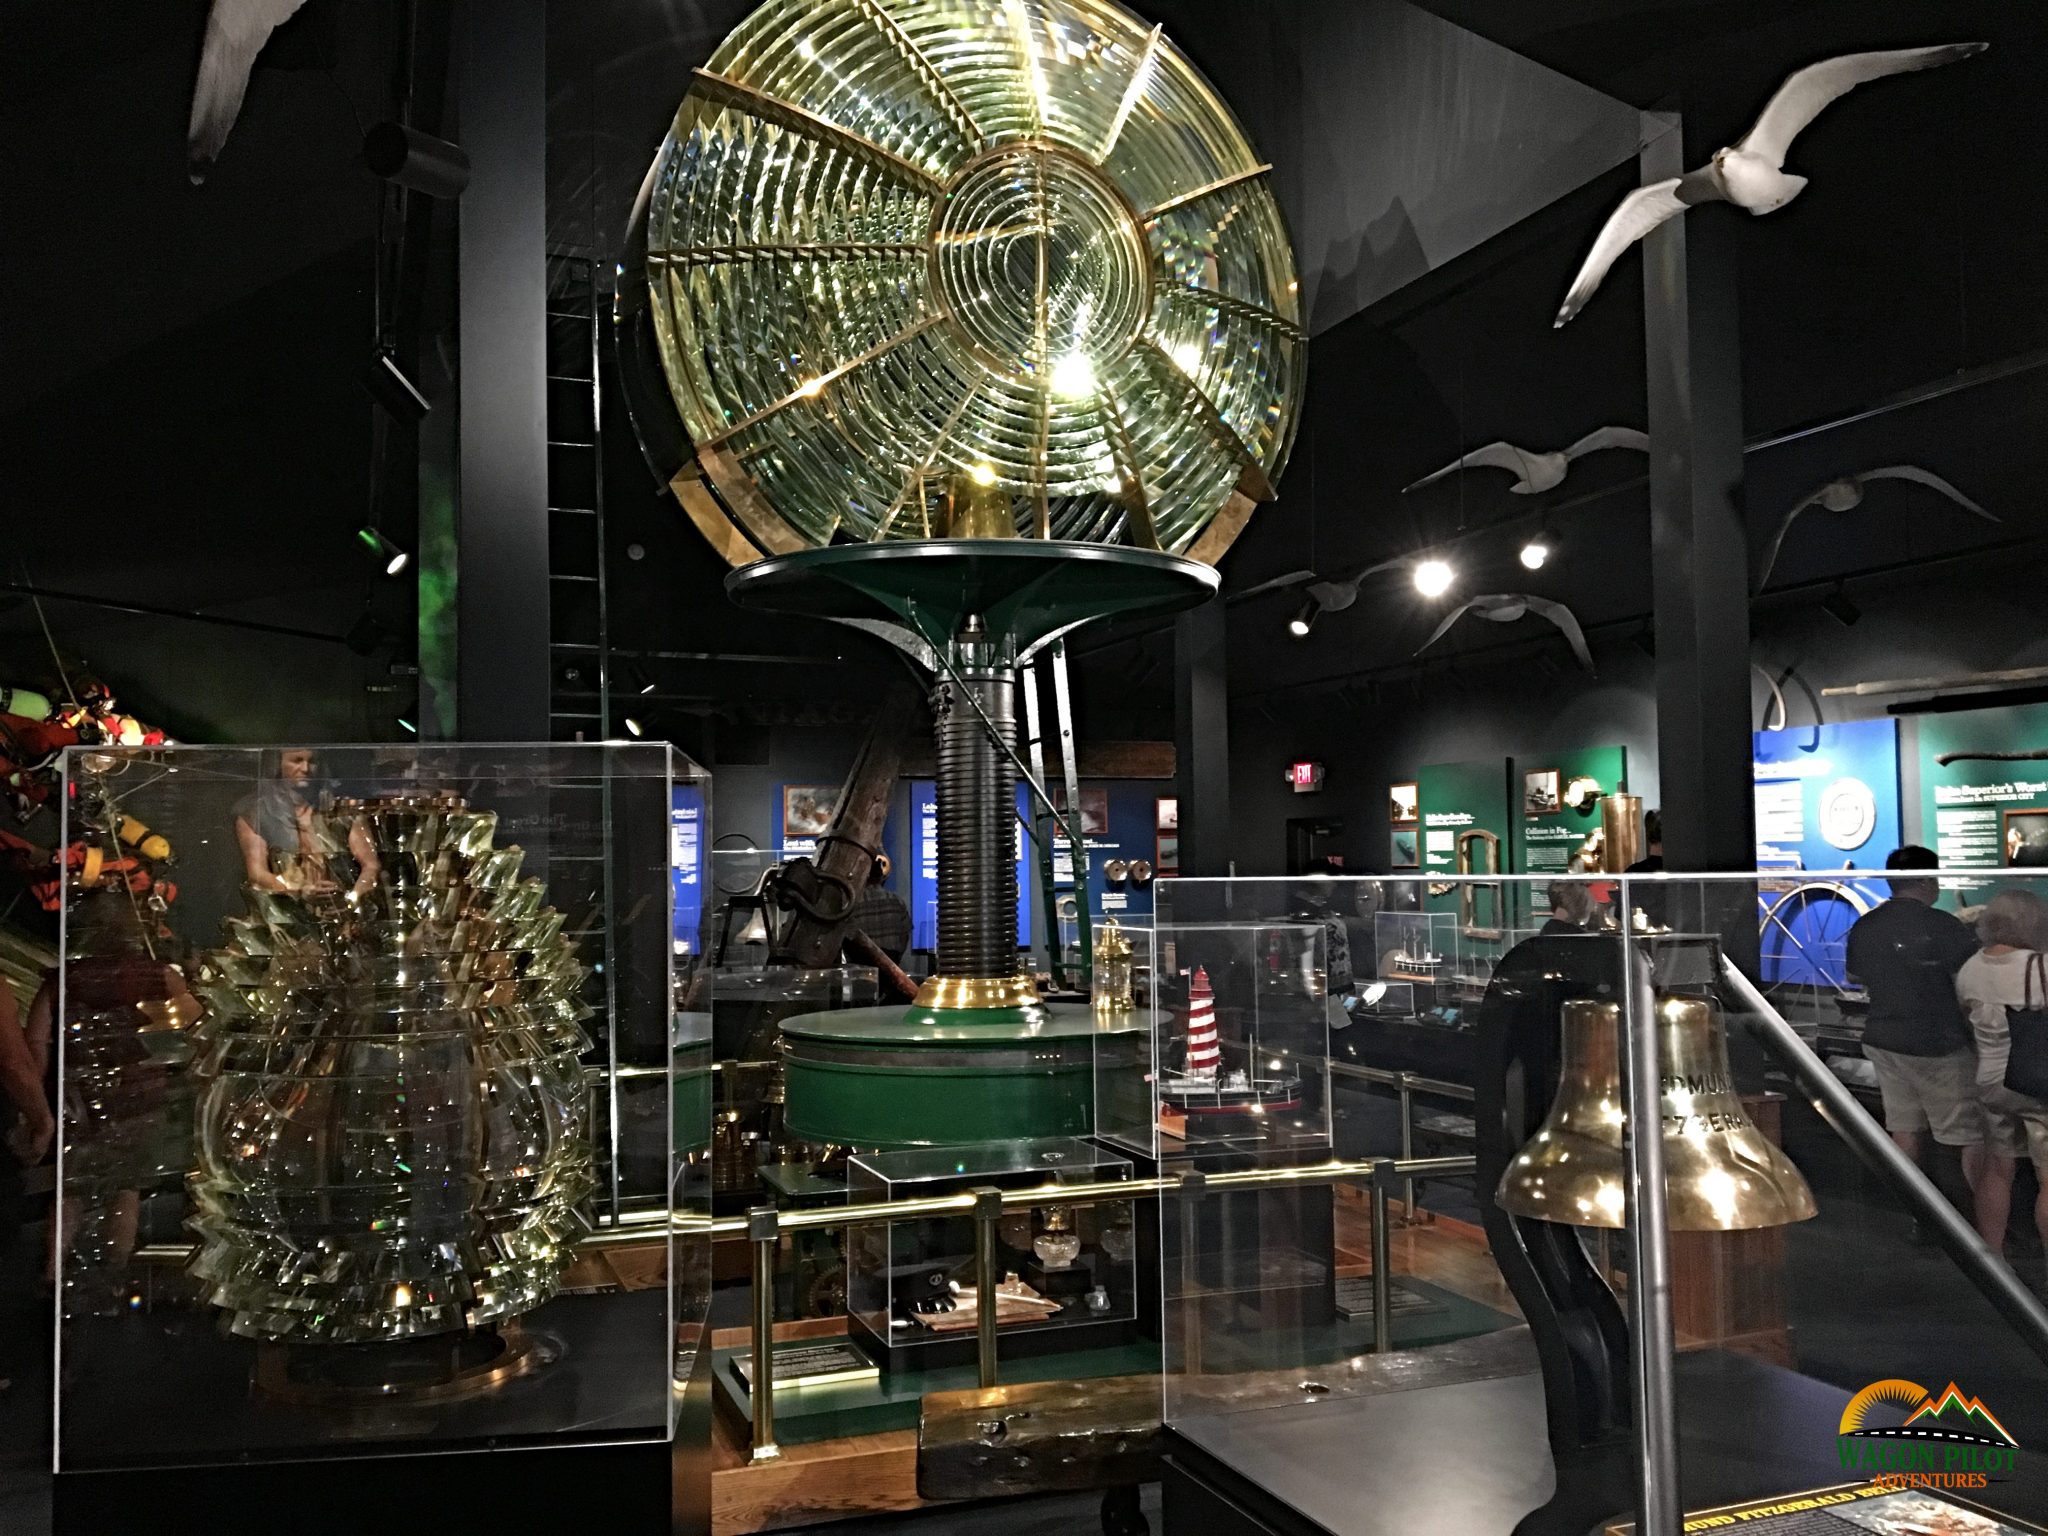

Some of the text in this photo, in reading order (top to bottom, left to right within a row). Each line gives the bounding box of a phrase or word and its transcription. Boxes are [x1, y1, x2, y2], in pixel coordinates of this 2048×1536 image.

[1961, 784, 2013, 798] Superior's
[1684, 1515, 1736, 1532] MUND
[1734, 1492, 1857, 1521] FITZGERALD
